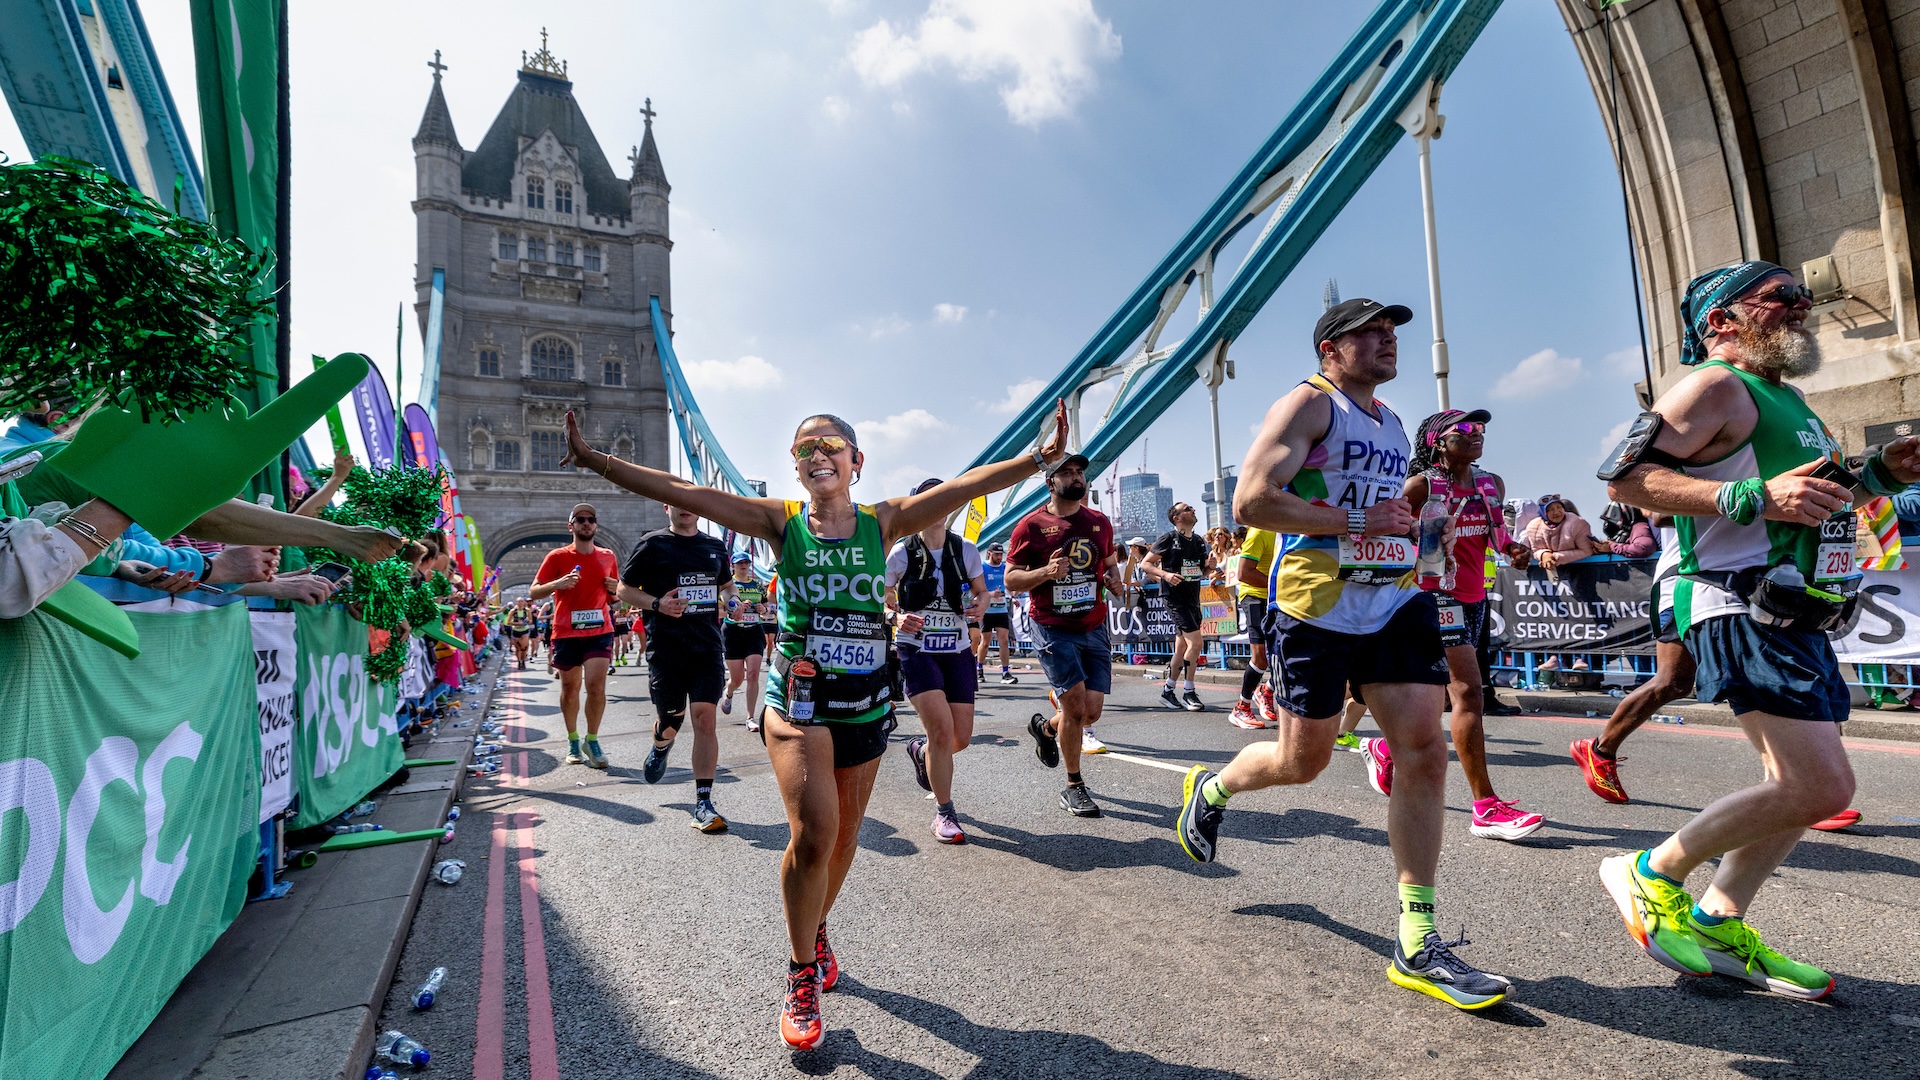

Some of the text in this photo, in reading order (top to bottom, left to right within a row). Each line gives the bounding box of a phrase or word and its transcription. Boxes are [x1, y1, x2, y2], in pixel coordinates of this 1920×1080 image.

[1454, 524, 1490, 538] ANDREA
[805, 547, 866, 568] SKYE
[1353, 541, 1405, 561] 30249
[679, 576, 697, 585] tcs
[686, 589, 713, 601] 57541
[1061, 586, 1090, 600] 59459
[1514, 580, 1574, 596] TATA
[576, 612, 599, 621] 72077
[1108, 598, 1166, 636] tcs TAT
[1211, 604, 1228, 619] NOW
[813, 611, 867, 633] tcs TATA
[924, 614, 956, 627] 6113
[1217, 620, 1237, 634] LATER
[846, 627, 873, 636] SERVICES
[1515, 622, 1609, 640] SERVICES
[926, 635, 956, 648] TIFF
[819, 643, 875, 666] 54564
